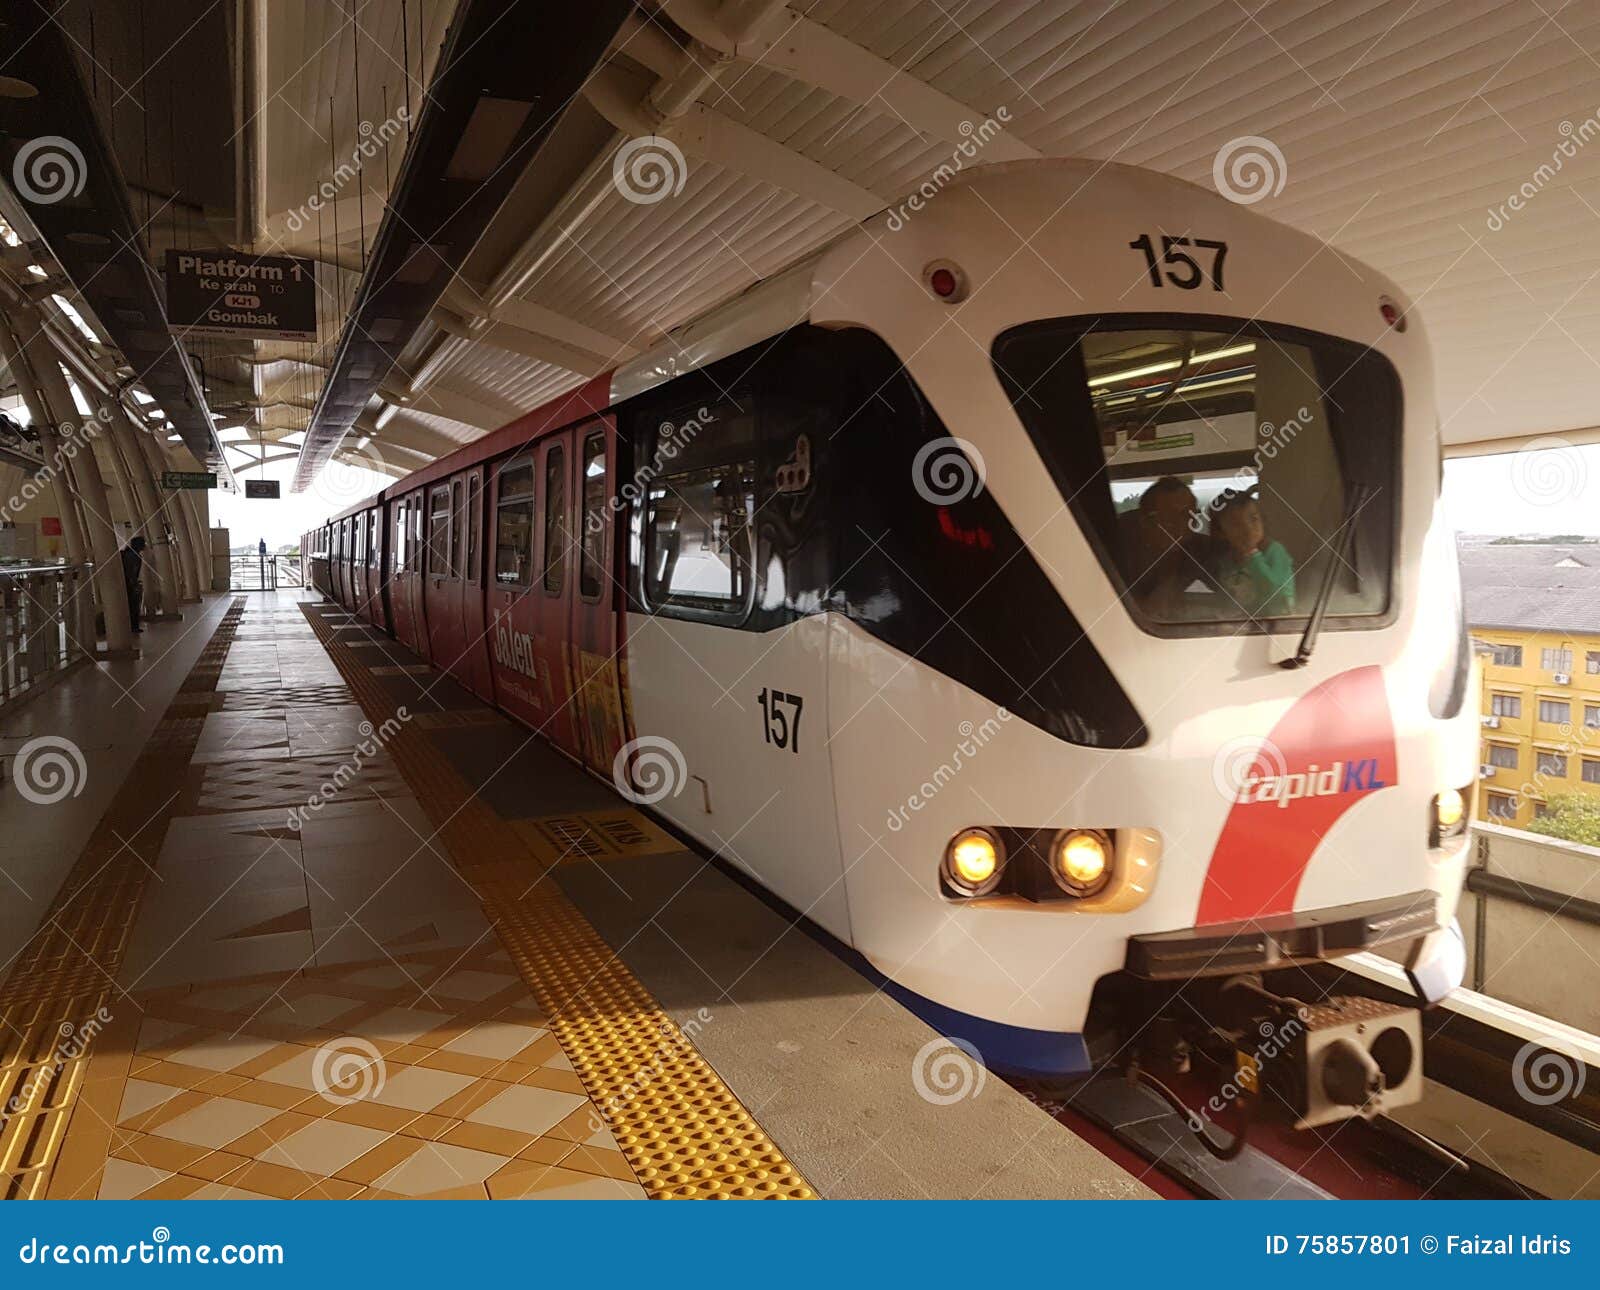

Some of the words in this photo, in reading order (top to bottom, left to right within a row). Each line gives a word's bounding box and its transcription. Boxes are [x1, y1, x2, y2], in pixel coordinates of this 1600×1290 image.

[179, 256, 283, 280] Platform
[290, 263, 303, 282] 1
[1129, 234, 1228, 292] 157
[200, 279, 220, 291] Ke
[224, 281, 257, 293] arah
[270, 284, 285, 295] TO
[231, 296, 253, 306] KJ1
[207, 309, 279, 326] Gombak
[758, 687, 803, 754] 157
